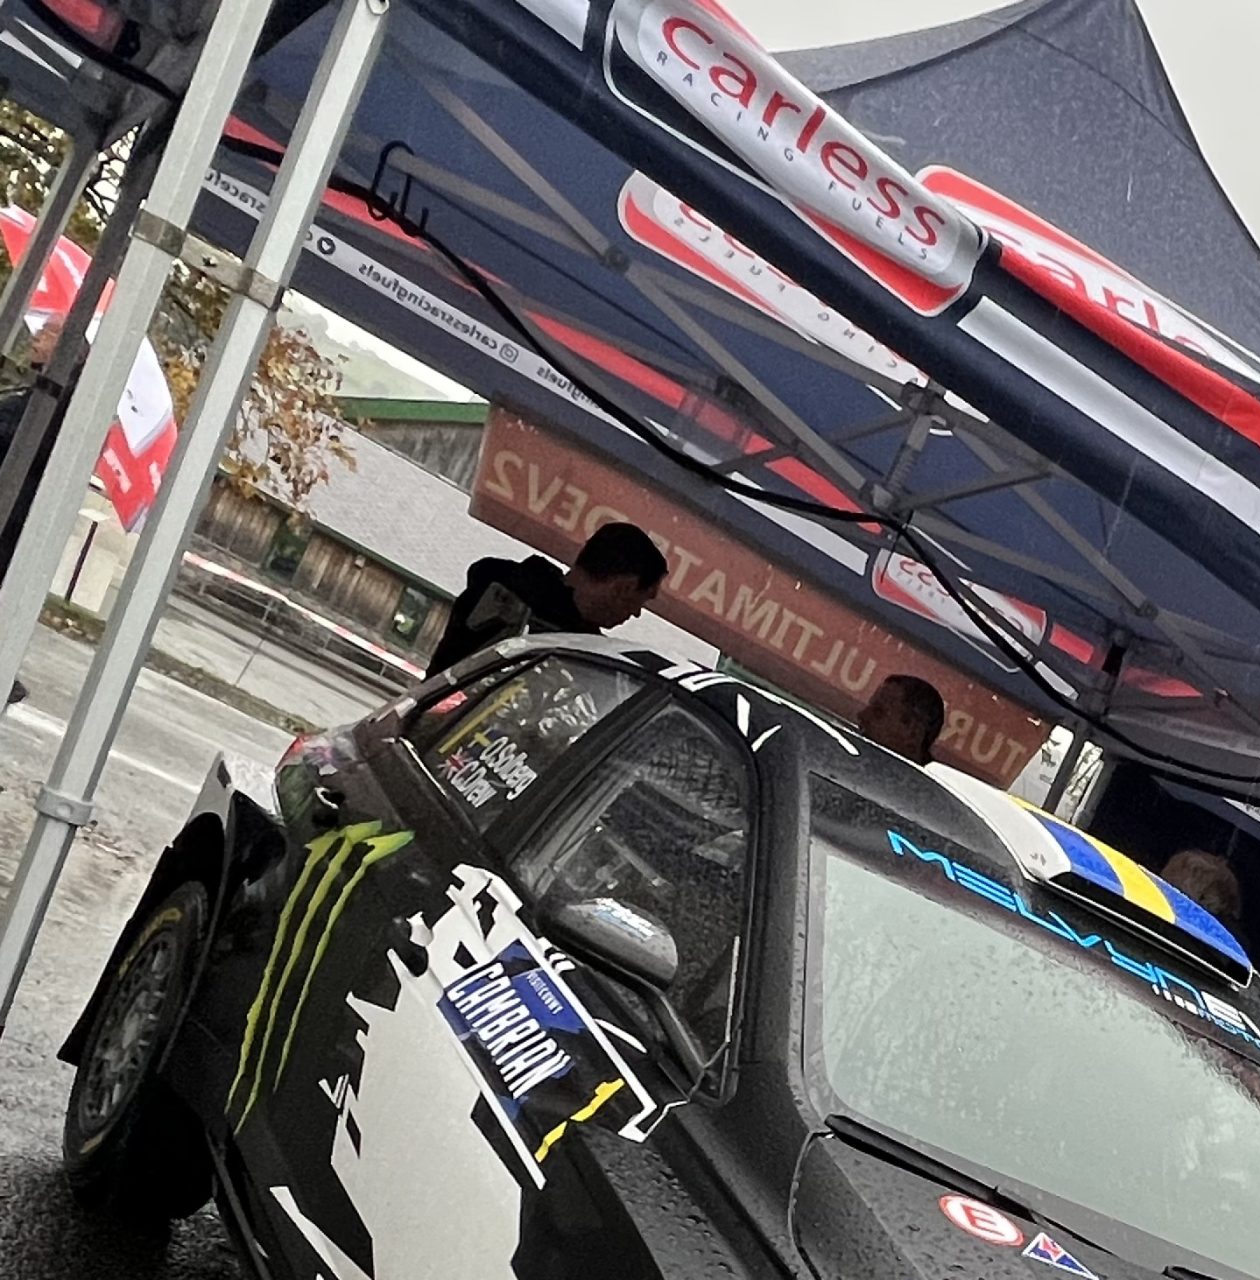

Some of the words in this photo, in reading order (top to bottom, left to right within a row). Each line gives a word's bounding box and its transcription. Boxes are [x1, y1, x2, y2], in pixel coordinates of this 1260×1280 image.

[655, 49, 797, 164] RACING
[828, 179, 929, 261] FUELS
[661, 16, 946, 247] carless
[447, 962, 571, 1099] CAMBRIAN
